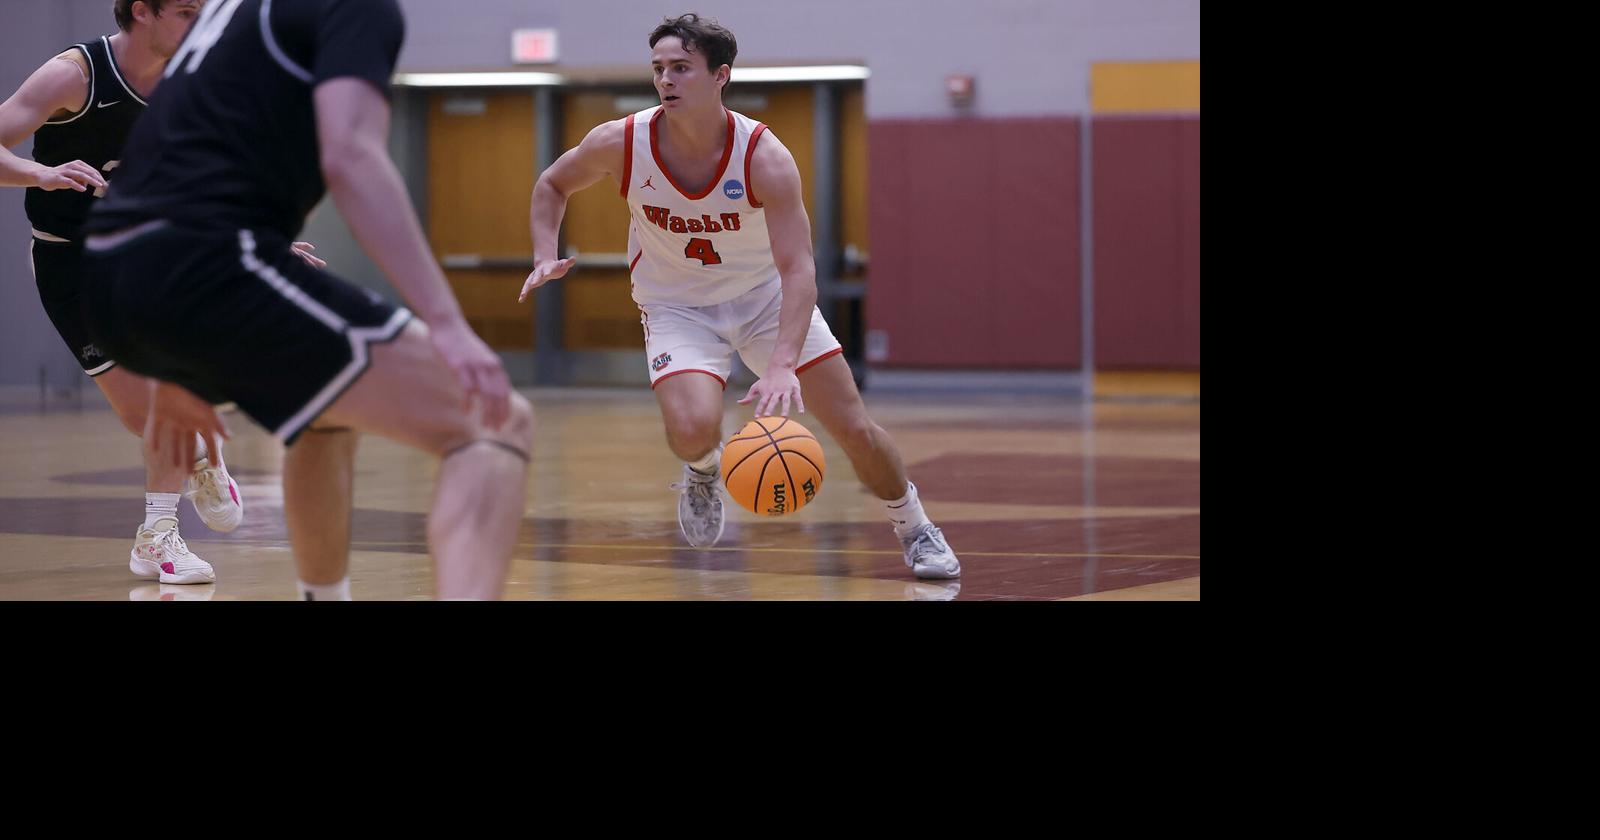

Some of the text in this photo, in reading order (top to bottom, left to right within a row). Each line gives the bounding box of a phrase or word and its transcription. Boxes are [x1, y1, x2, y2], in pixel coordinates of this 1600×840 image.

[641, 204, 741, 233] WashU
[684, 237, 722, 266] 4
[767, 482, 786, 515] lson
